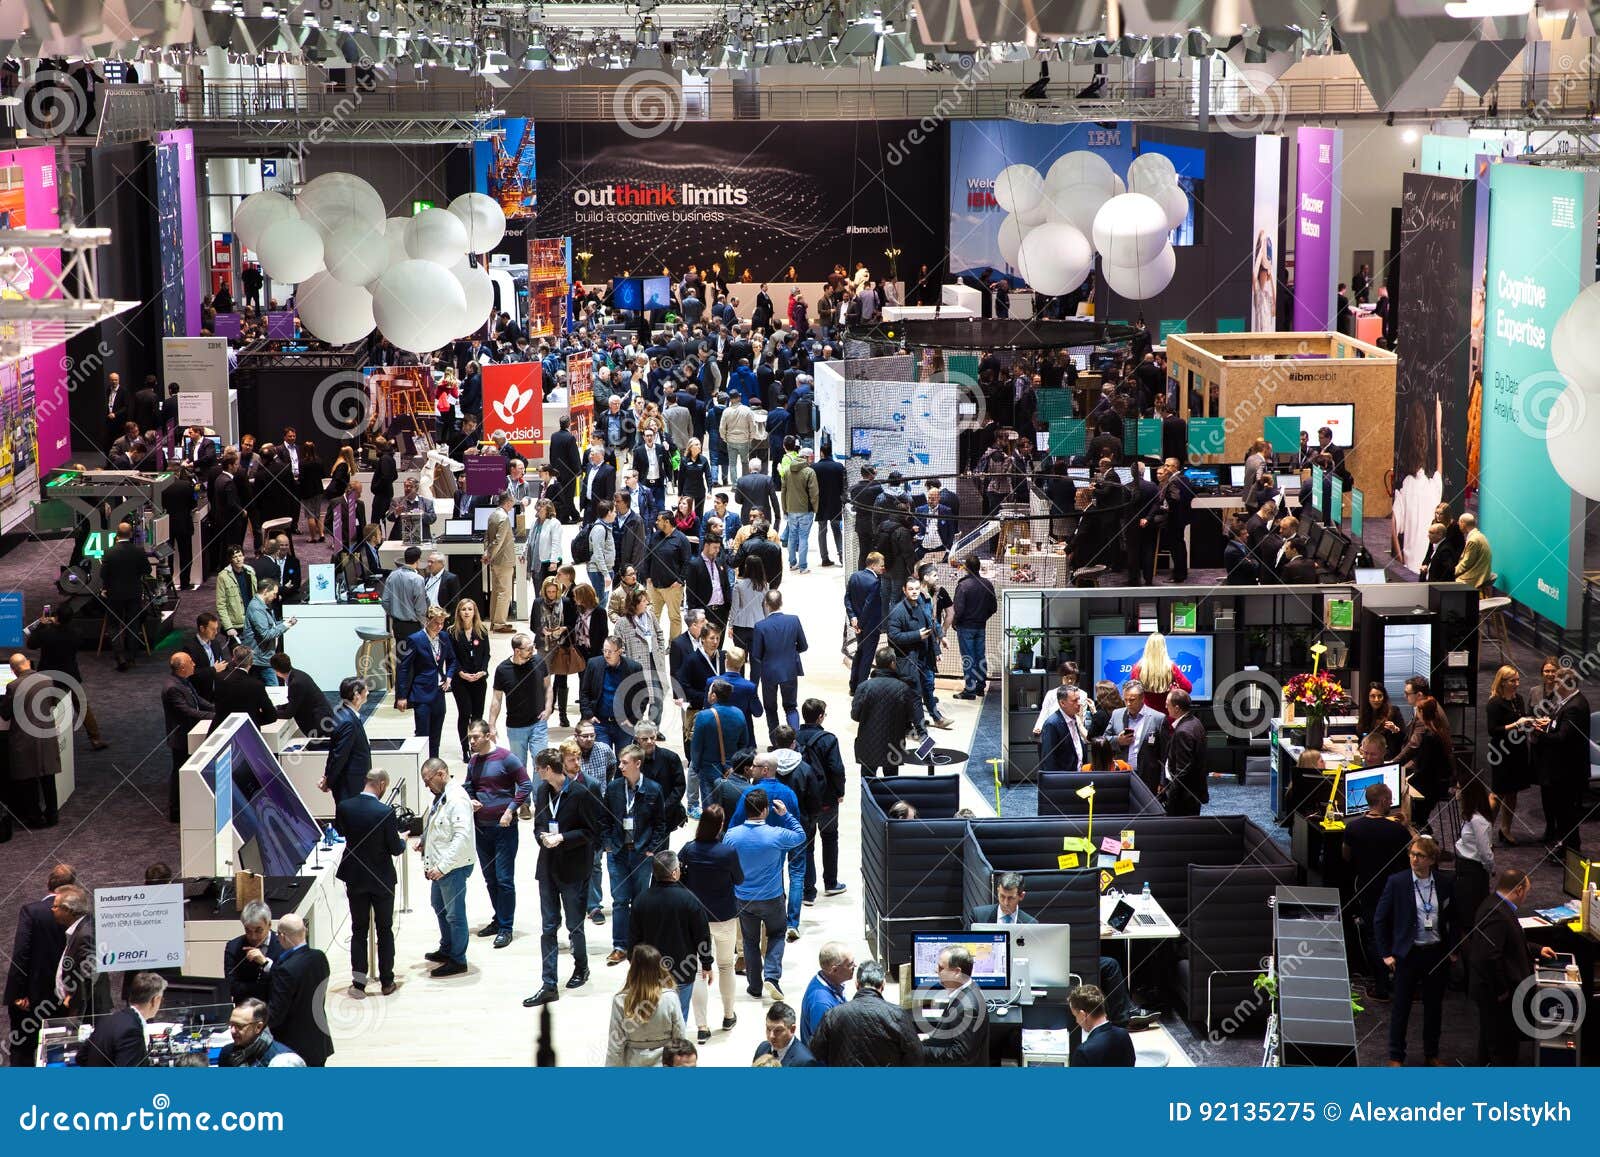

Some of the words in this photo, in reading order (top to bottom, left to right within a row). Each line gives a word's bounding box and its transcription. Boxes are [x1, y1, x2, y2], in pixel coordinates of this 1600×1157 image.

[1088, 131, 1121, 146] IBM
[967, 178, 996, 189] Welc
[574, 184, 676, 206] outthink
[682, 184, 748, 205] limits
[575, 211, 604, 223] build
[607, 214, 615, 222] a
[617, 210, 670, 224] cognitive
[672, 210, 725, 222] business
[846, 226, 889, 234] #ibmcebit
[1498, 269, 1546, 309] Cognitive
[1496, 308, 1546, 349] Expertise
[1289, 371, 1337, 382] #ibmcebit
[1120, 665, 1133, 673] 3D
[100, 894, 132, 902] Industry
[100, 911, 141, 919] Warehouse
[142, 909, 168, 917] Control
[118, 950, 148, 960] PROFI
[166, 952, 179, 961] 63
